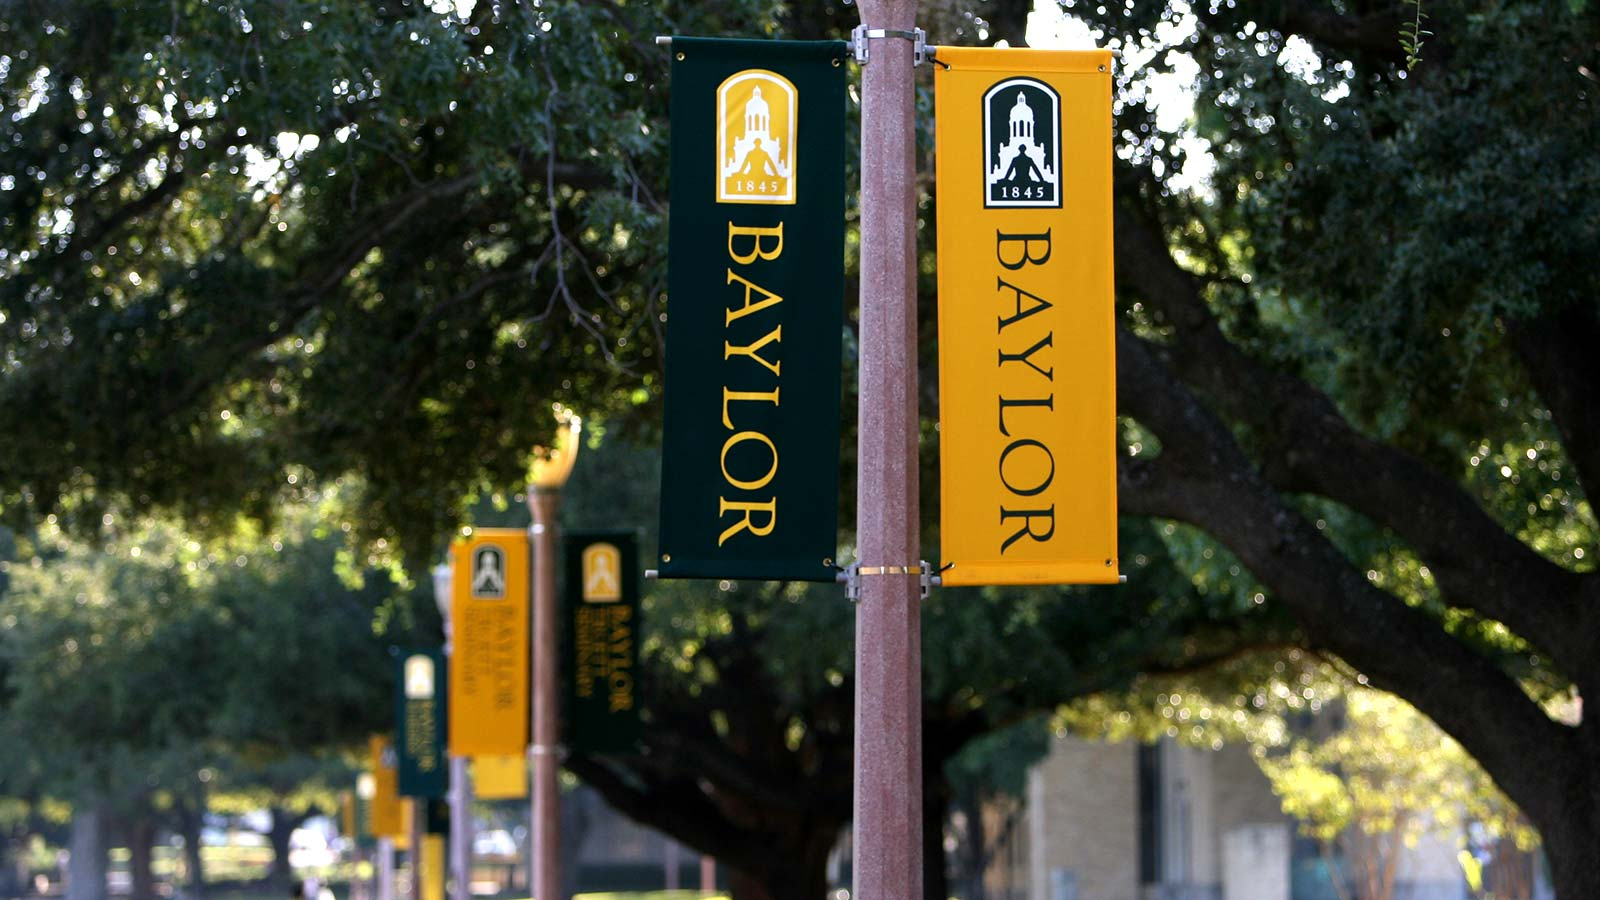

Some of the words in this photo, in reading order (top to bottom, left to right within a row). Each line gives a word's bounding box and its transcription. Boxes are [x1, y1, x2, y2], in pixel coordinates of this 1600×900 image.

[736, 180, 778, 193] 1845
[1001, 186, 1044, 199] 1845
[718, 220, 784, 547] BAYLOR
[996, 227, 1056, 555] BAYLOR
[607, 604, 633, 713] BAYLOR
